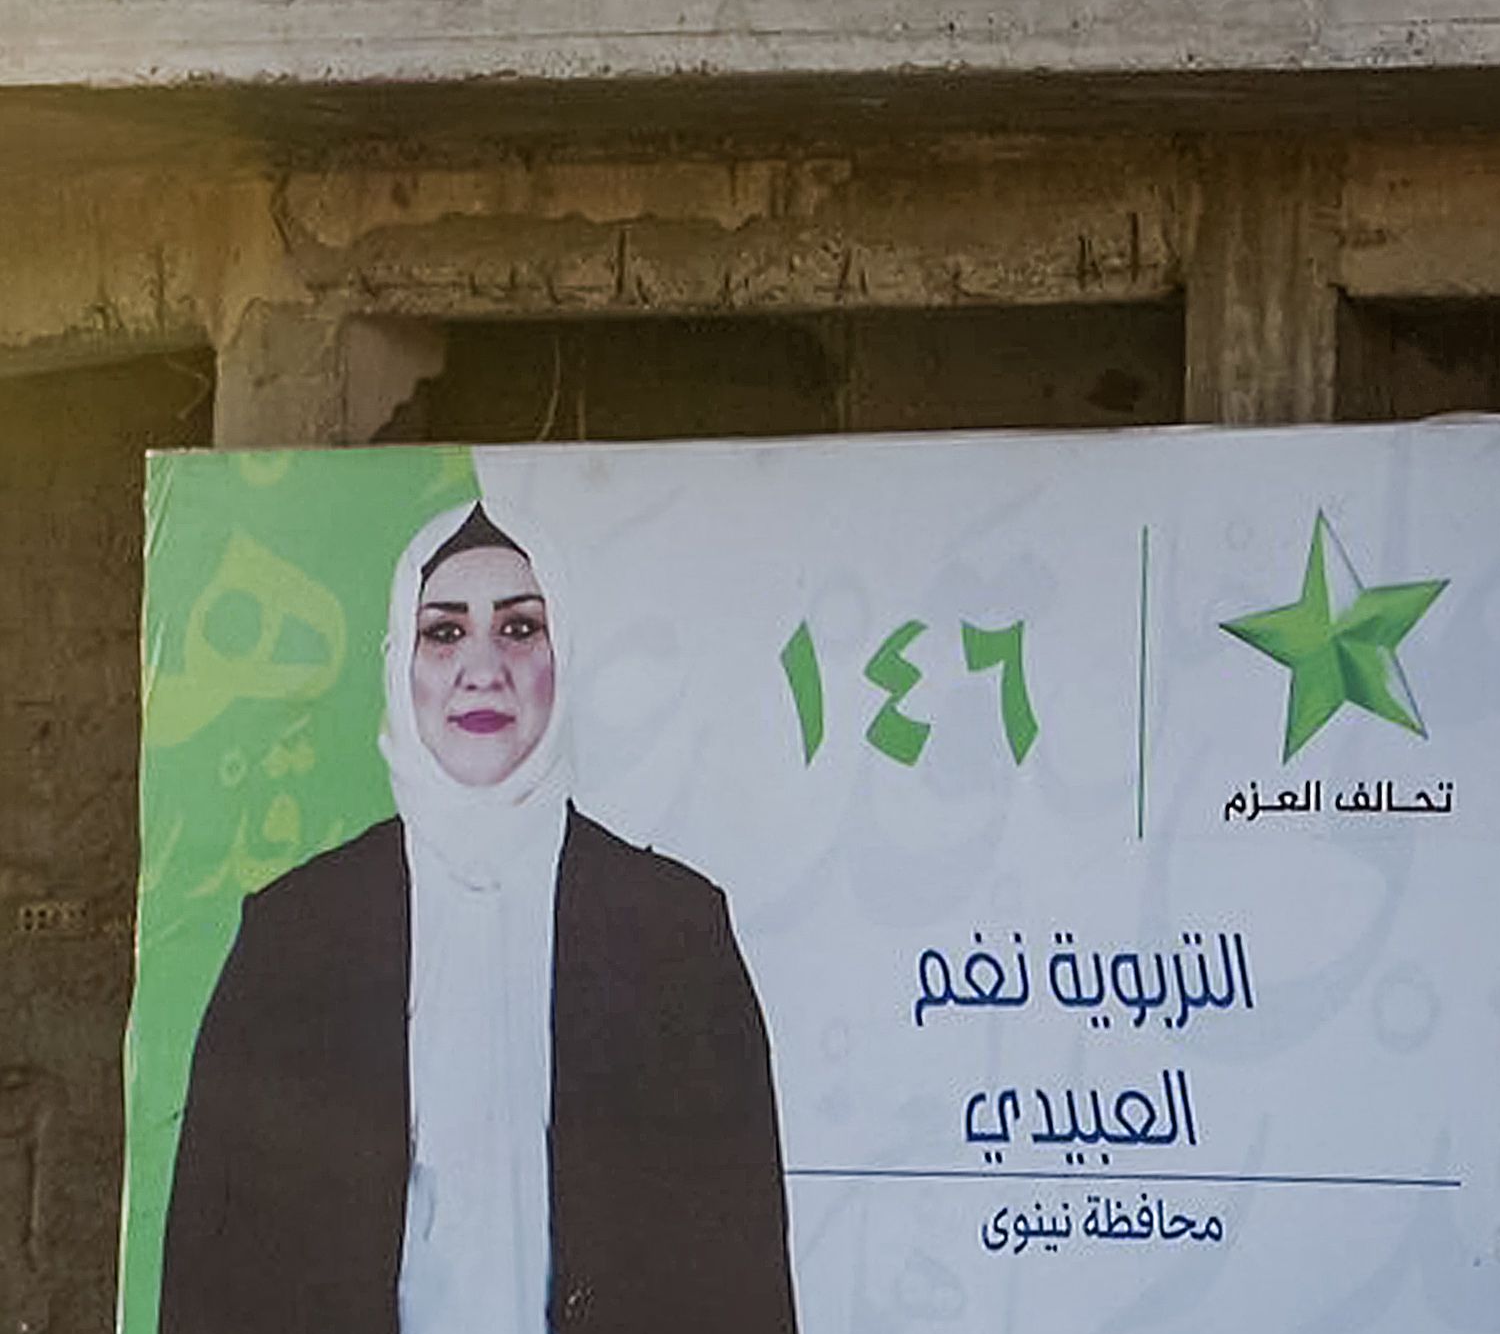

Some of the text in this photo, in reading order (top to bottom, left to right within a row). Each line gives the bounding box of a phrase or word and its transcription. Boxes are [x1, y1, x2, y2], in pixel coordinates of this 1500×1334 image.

[779, 619, 1039, 767] ١٤٦
[1224, 780, 1454, 822] تحالف العزم
[914, 932, 1253, 1028] التربوية نغم
[964, 1069, 1198, 1164] العبيدي
[981, 1192, 1224, 1254] محافظة نينوى
